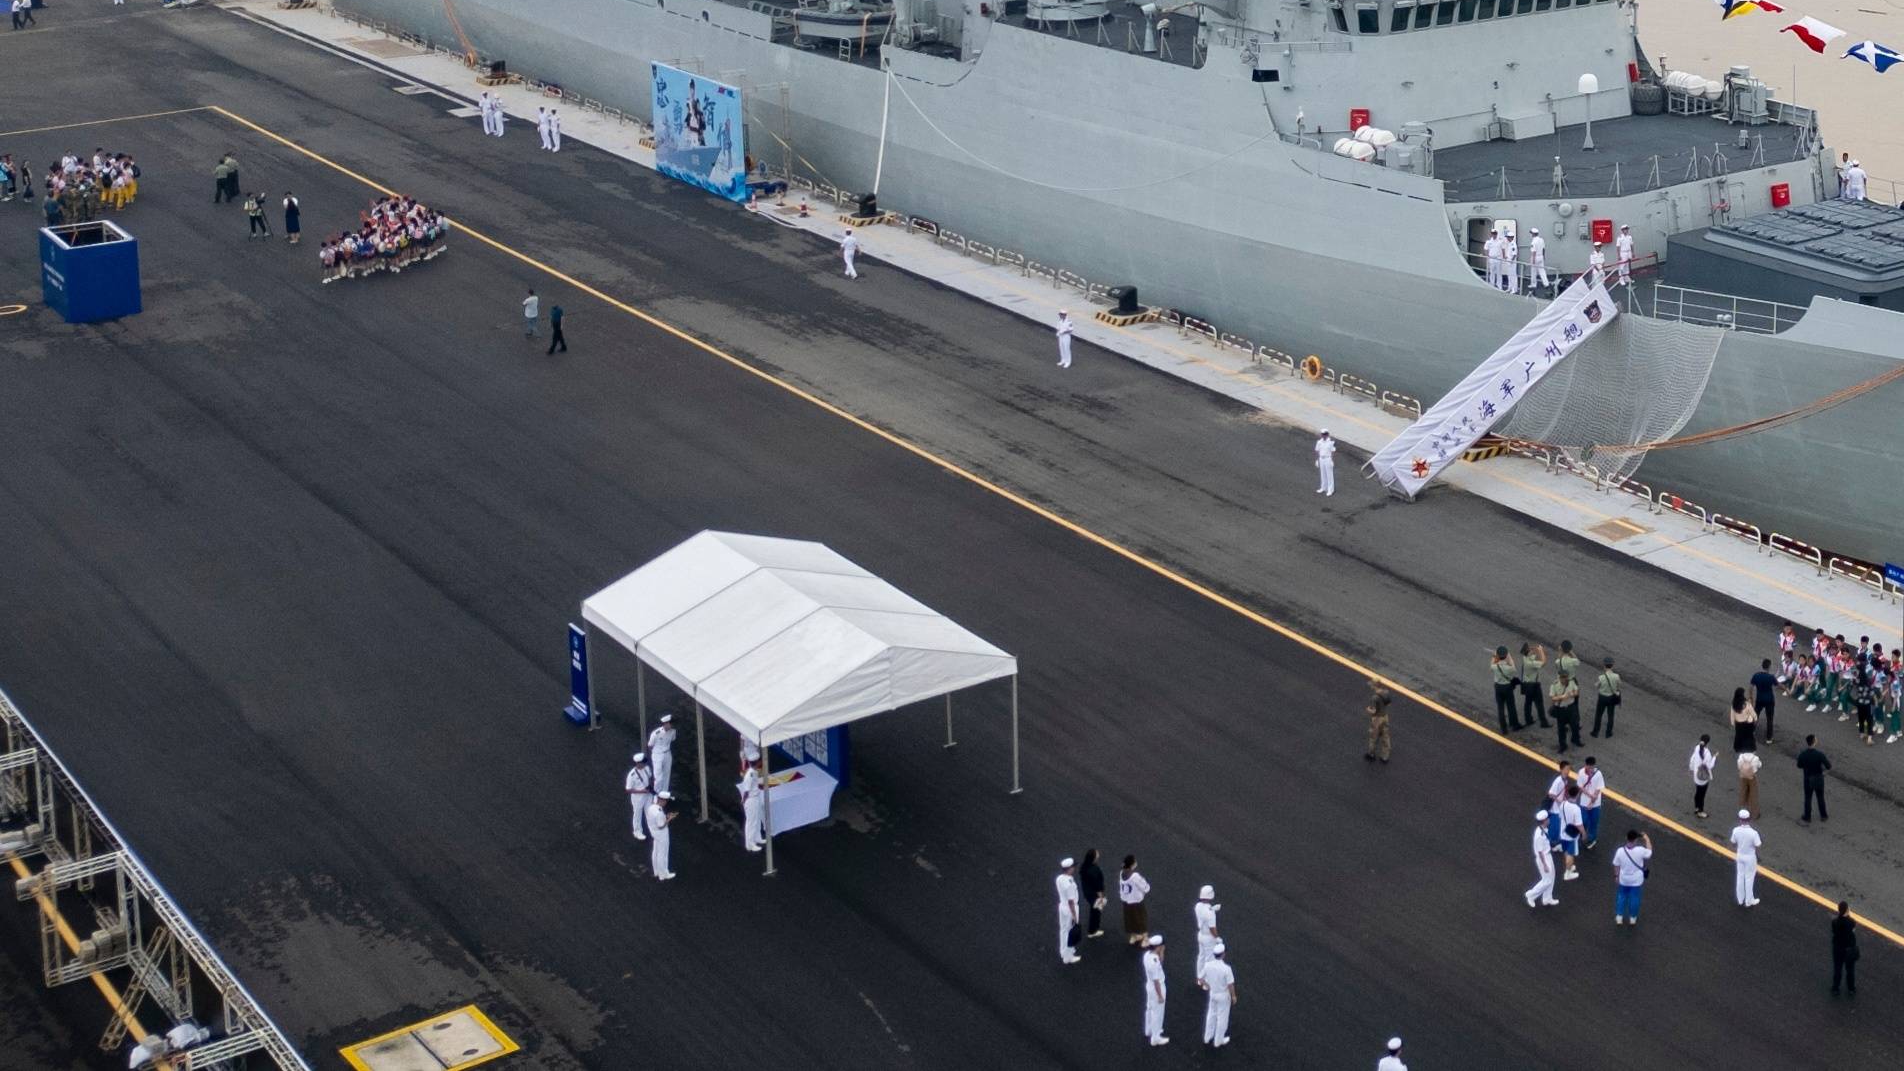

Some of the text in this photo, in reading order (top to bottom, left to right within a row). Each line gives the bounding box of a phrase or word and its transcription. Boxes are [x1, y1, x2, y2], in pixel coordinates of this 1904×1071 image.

[1477, 322, 1584, 421] 海军广州舰
